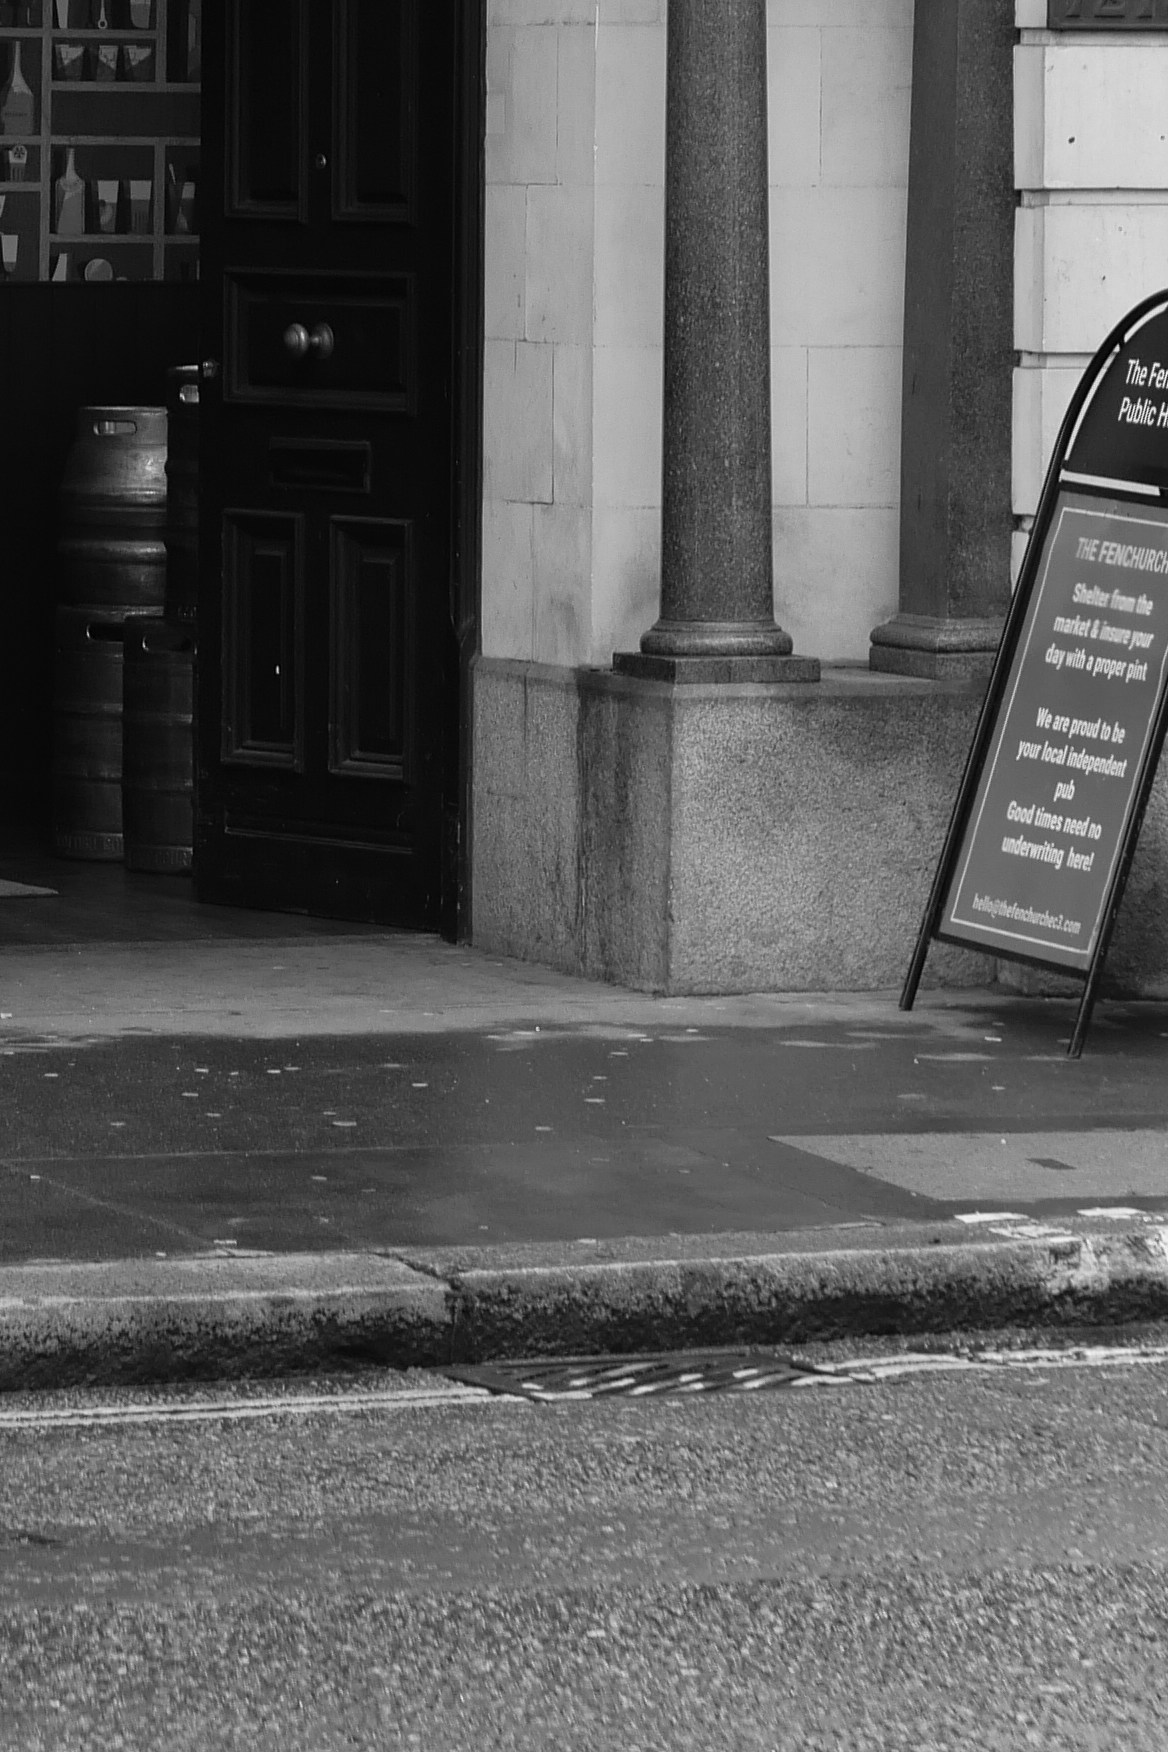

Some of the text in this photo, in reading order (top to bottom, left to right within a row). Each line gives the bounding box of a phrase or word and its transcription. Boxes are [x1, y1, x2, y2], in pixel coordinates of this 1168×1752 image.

[1125, 358, 1148, 386] The
[1117, 396, 1157, 427] Public
[1075, 537, 1168, 574] THE FENCHURCH
[1072, 582, 1154, 616] Shelter from the
[1053, 614, 1154, 650] market & insure your
[1045, 642, 1148, 683] day with a proper pint
[1036, 707, 1126, 744] We are proud to be
[1016, 740, 1127, 778] your local independent
[1053, 779, 1076, 802] pub
[1006, 800, 1103, 840] Good times need no
[1001, 834, 1095, 872] underwriting here!
